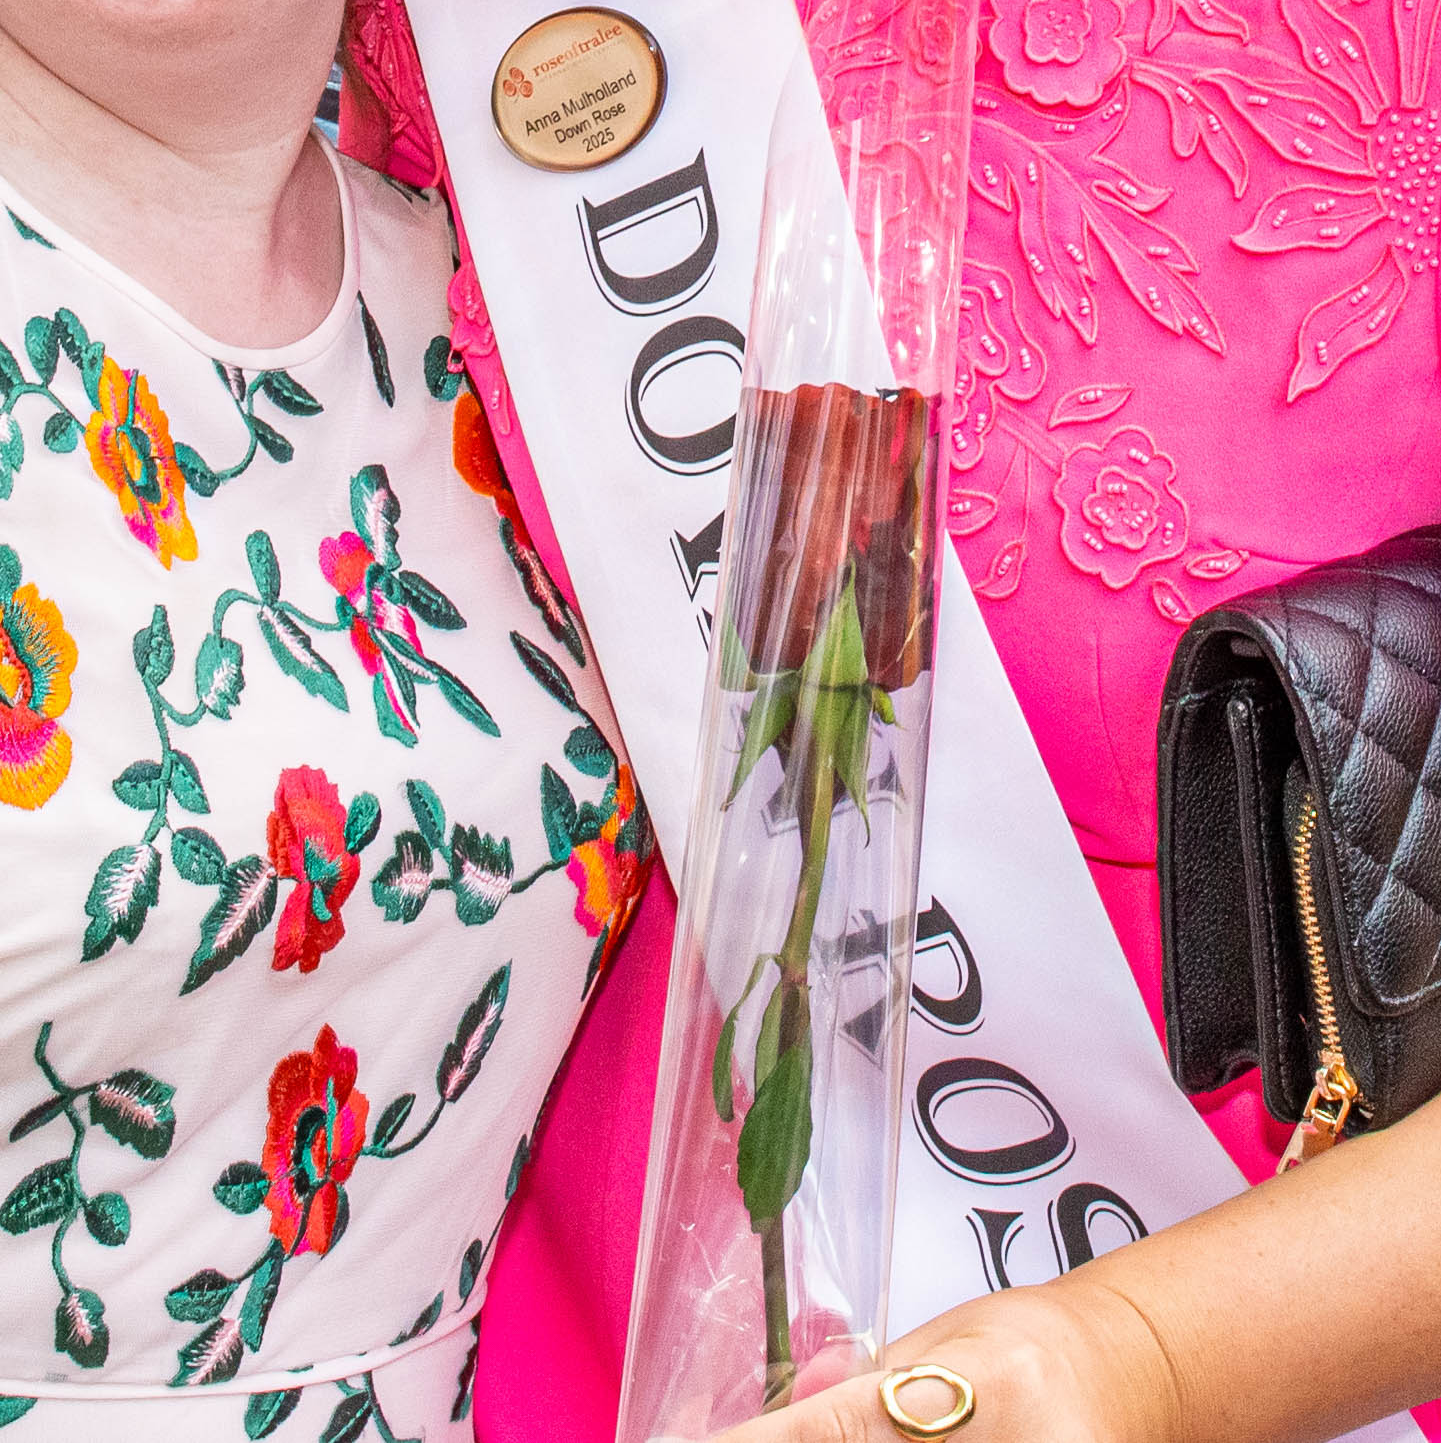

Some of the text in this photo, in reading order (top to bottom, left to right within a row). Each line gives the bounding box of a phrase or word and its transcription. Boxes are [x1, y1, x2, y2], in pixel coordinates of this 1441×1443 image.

[525, 70, 637, 137] Anna Mulholland
[554, 102, 626, 144] Down Rose
[582, 127, 615, 153] 2025
